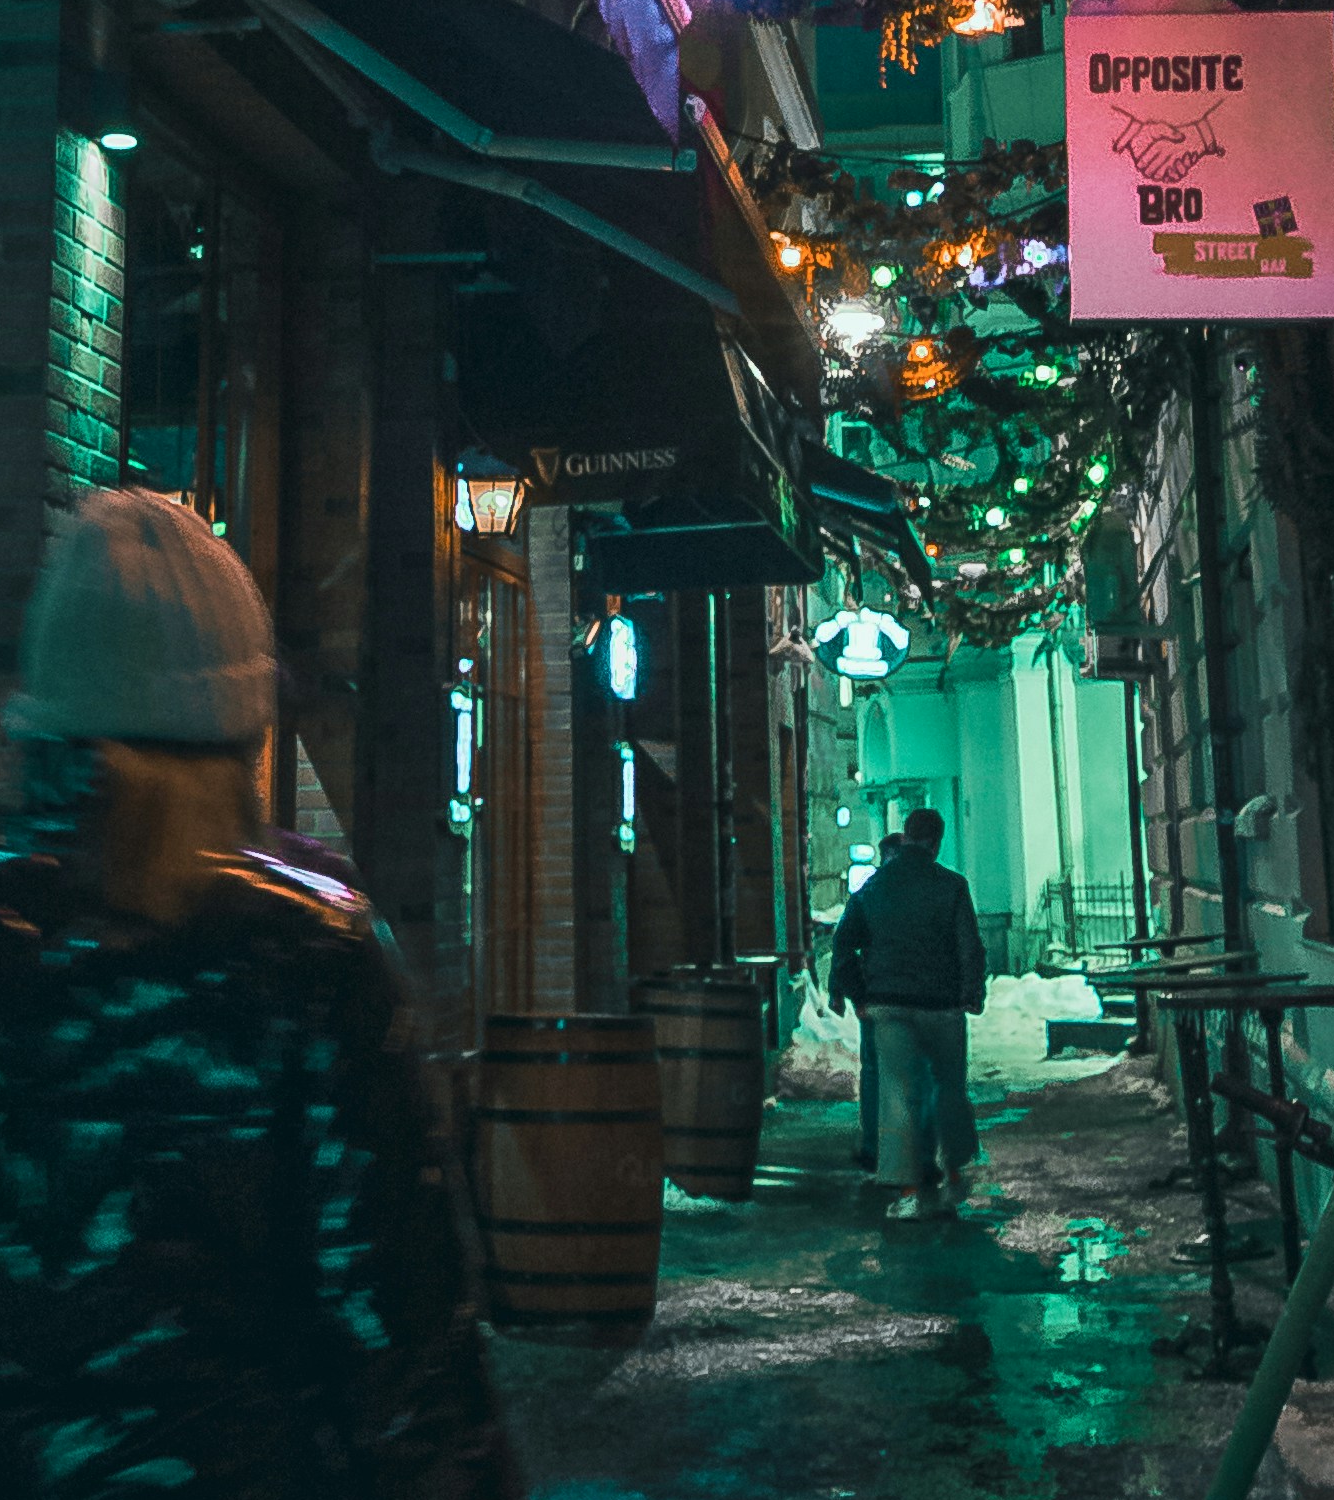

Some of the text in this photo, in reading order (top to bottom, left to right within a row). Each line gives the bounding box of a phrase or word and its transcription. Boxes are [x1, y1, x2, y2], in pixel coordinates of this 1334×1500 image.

[1088, 52, 1244, 94] OPPOSITE
[1137, 184, 1204, 226] BRO
[1193, 240, 1260, 263] STREET
[565, 446, 678, 477] GUINNESS
